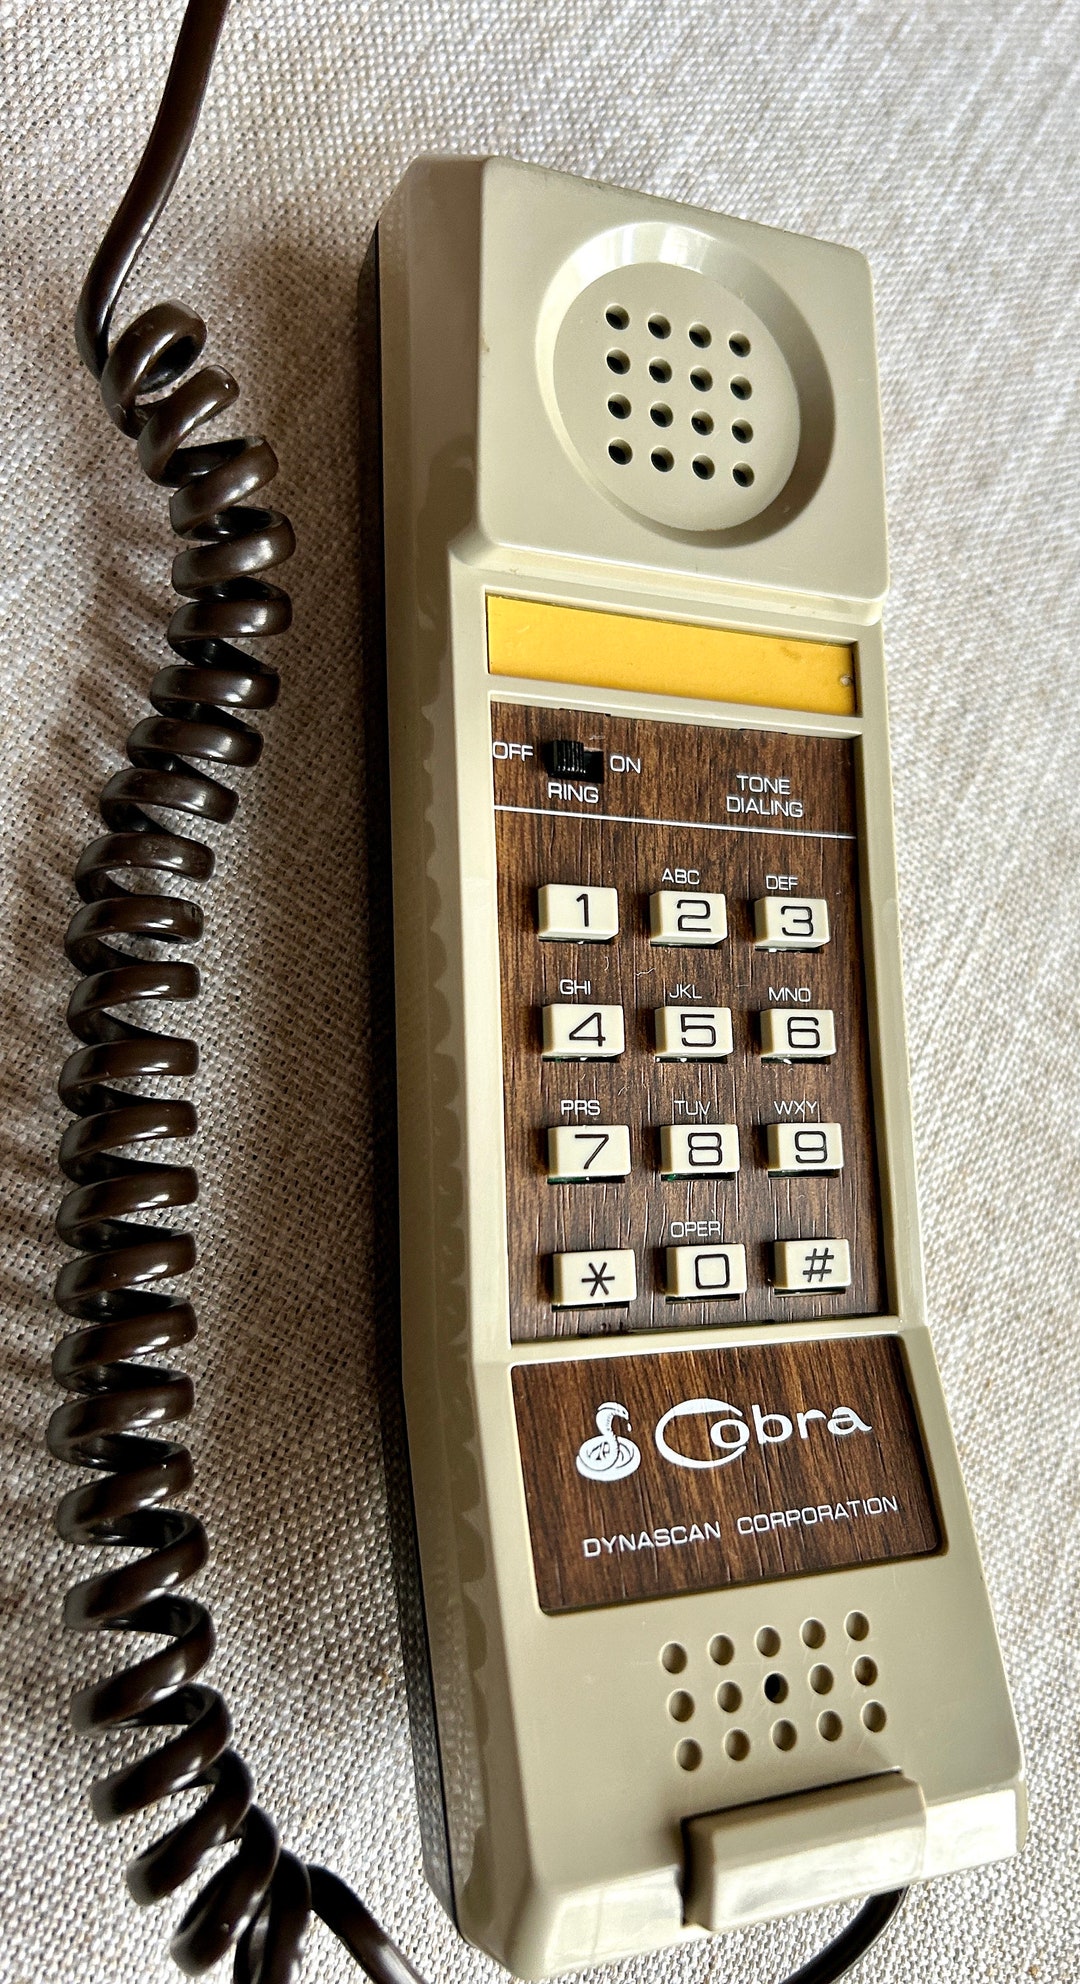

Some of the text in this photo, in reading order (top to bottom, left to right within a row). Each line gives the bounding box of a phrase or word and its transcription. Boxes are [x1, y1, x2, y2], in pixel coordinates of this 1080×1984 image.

[493, 742, 533, 762] OFF
[610, 756, 641, 774] ON
[548, 782, 599, 803] RING
[737, 775, 790, 795] TONE
[727, 796, 803, 818] DIALING
[662, 869, 699, 885] ABC
[766, 875, 798, 890] DEF
[576, 894, 589, 927] 1
[677, 900, 712, 932] 2
[781, 906, 813, 937] 3
[560, 980, 591, 995] GHI
[670, 984, 702, 999] JKL
[769, 988, 811, 1002] MNO
[569, 1012, 606, 1047] 4
[681, 1014, 716, 1047] 5
[787, 1016, 820, 1048] 6
[561, 1100, 600, 1116] PRS
[675, 1101, 710, 1115] TUV
[774, 1101, 817, 1114] WXY
[575, 1134, 609, 1169] 7
[687, 1132, 723, 1166] 8
[794, 1130, 828, 1163] 9
[671, 1221, 720, 1238] OPER
[803, 1248, 834, 1282] #
[655, 1398, 872, 1468] Cobra
[583, 1496, 898, 1557] DYNASCAN CORPORATION
